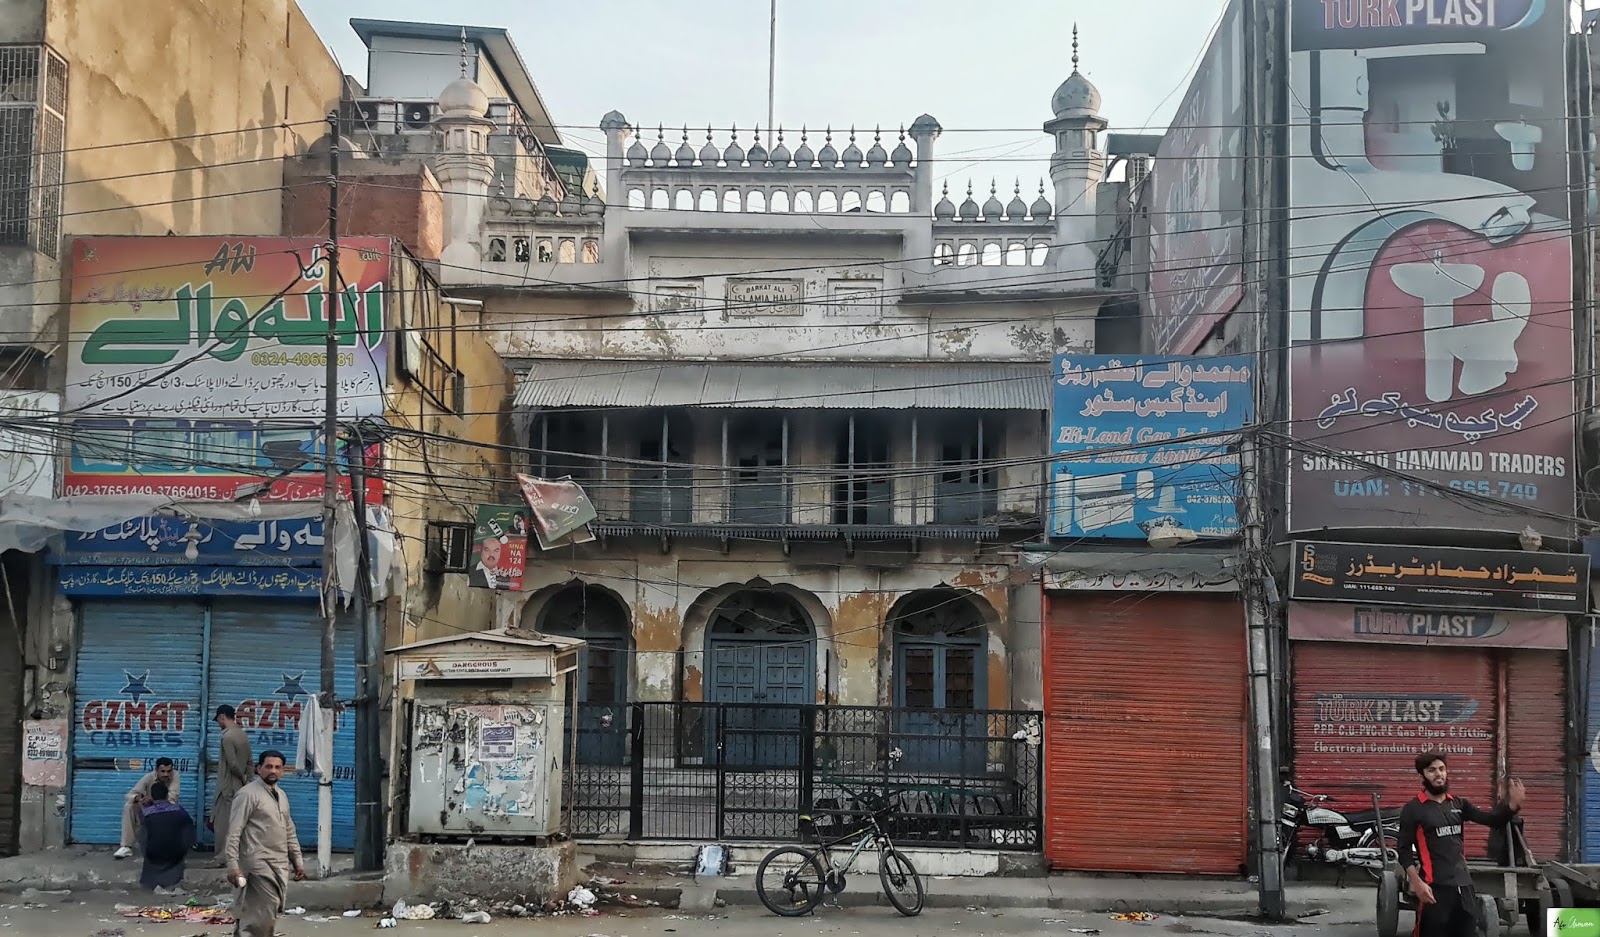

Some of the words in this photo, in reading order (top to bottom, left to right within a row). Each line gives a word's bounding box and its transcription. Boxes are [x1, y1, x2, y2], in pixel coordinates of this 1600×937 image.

[204, 241, 256, 277] AW
[746, 285, 771, 293] BARKAT
[774, 285, 785, 293] ALI
[734, 295, 770, 303] ISLAMIA
[251, 351, 354, 367] 0324-486681
[1057, 426, 1134, 444] Hi-Land
[1136, 426, 1171, 443] Gas
[1396, 450, 1483, 471] HAMMAD
[1489, 452, 1566, 477] TRADERS
[1334, 479, 1390, 496] UAN:
[489, 519, 502, 535] PTI
[1345, 553, 1425, 579] ٹریڈرز
[1426, 560, 1491, 579] حماد
[1493, 563, 1578, 585] شہزاد
[82, 699, 190, 732] AZMAT
[91, 731, 183, 748] CABLES
[245, 730, 298, 745] ABL
[1397, 726, 1415, 736] Gas
[1418, 726, 1446, 739] Pipes
[1458, 727, 1493, 739] Fitting
[1314, 741, 1366, 753] Electrical
[1370, 742, 1417, 753] Conduits
[1439, 743, 1474, 755] Fitting
